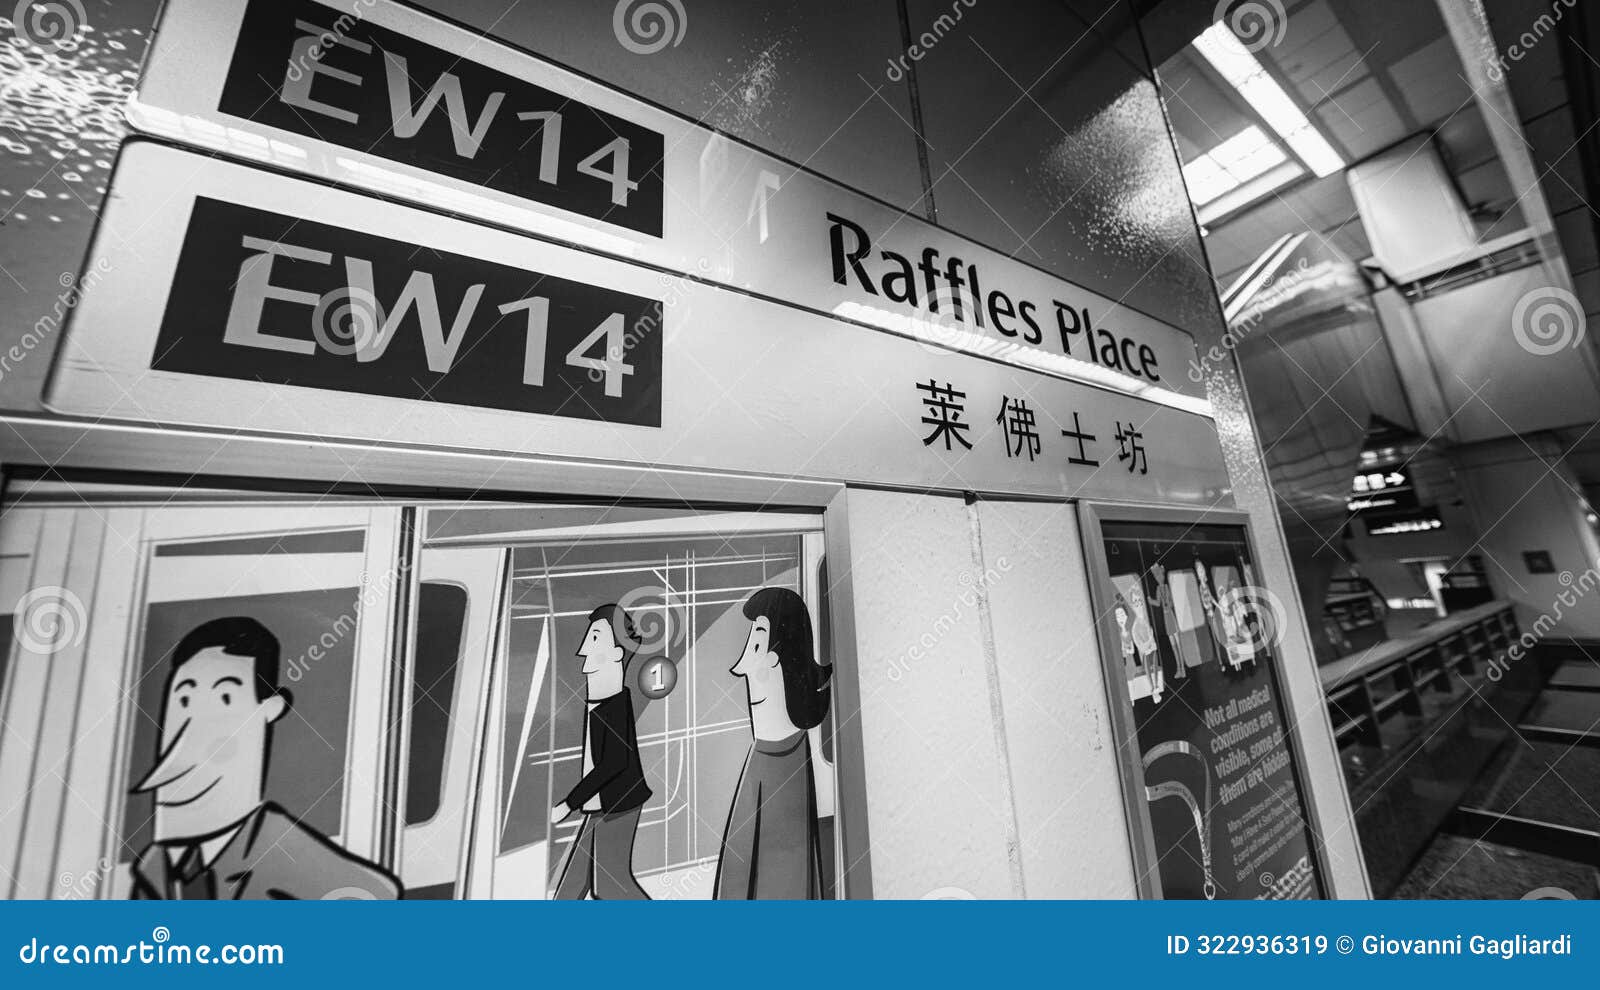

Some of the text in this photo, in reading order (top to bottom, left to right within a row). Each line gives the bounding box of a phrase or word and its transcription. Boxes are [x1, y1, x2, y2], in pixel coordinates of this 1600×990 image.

[279, 18, 639, 208] EW14
[223, 235, 635, 398] EW14
[826, 211, 1161, 382] Raffles Place
[916, 378, 1148, 476] 莱佛士坊
[650, 662, 665, 691] 1
[1204, 684, 1270, 729] Not all medical
[1210, 710, 1274, 754] conditions are
[1215, 748, 1251, 779] visible,
[1249, 735, 1274, 760] some
[1219, 778, 1248, 806] them
[1246, 767, 1264, 789] are
